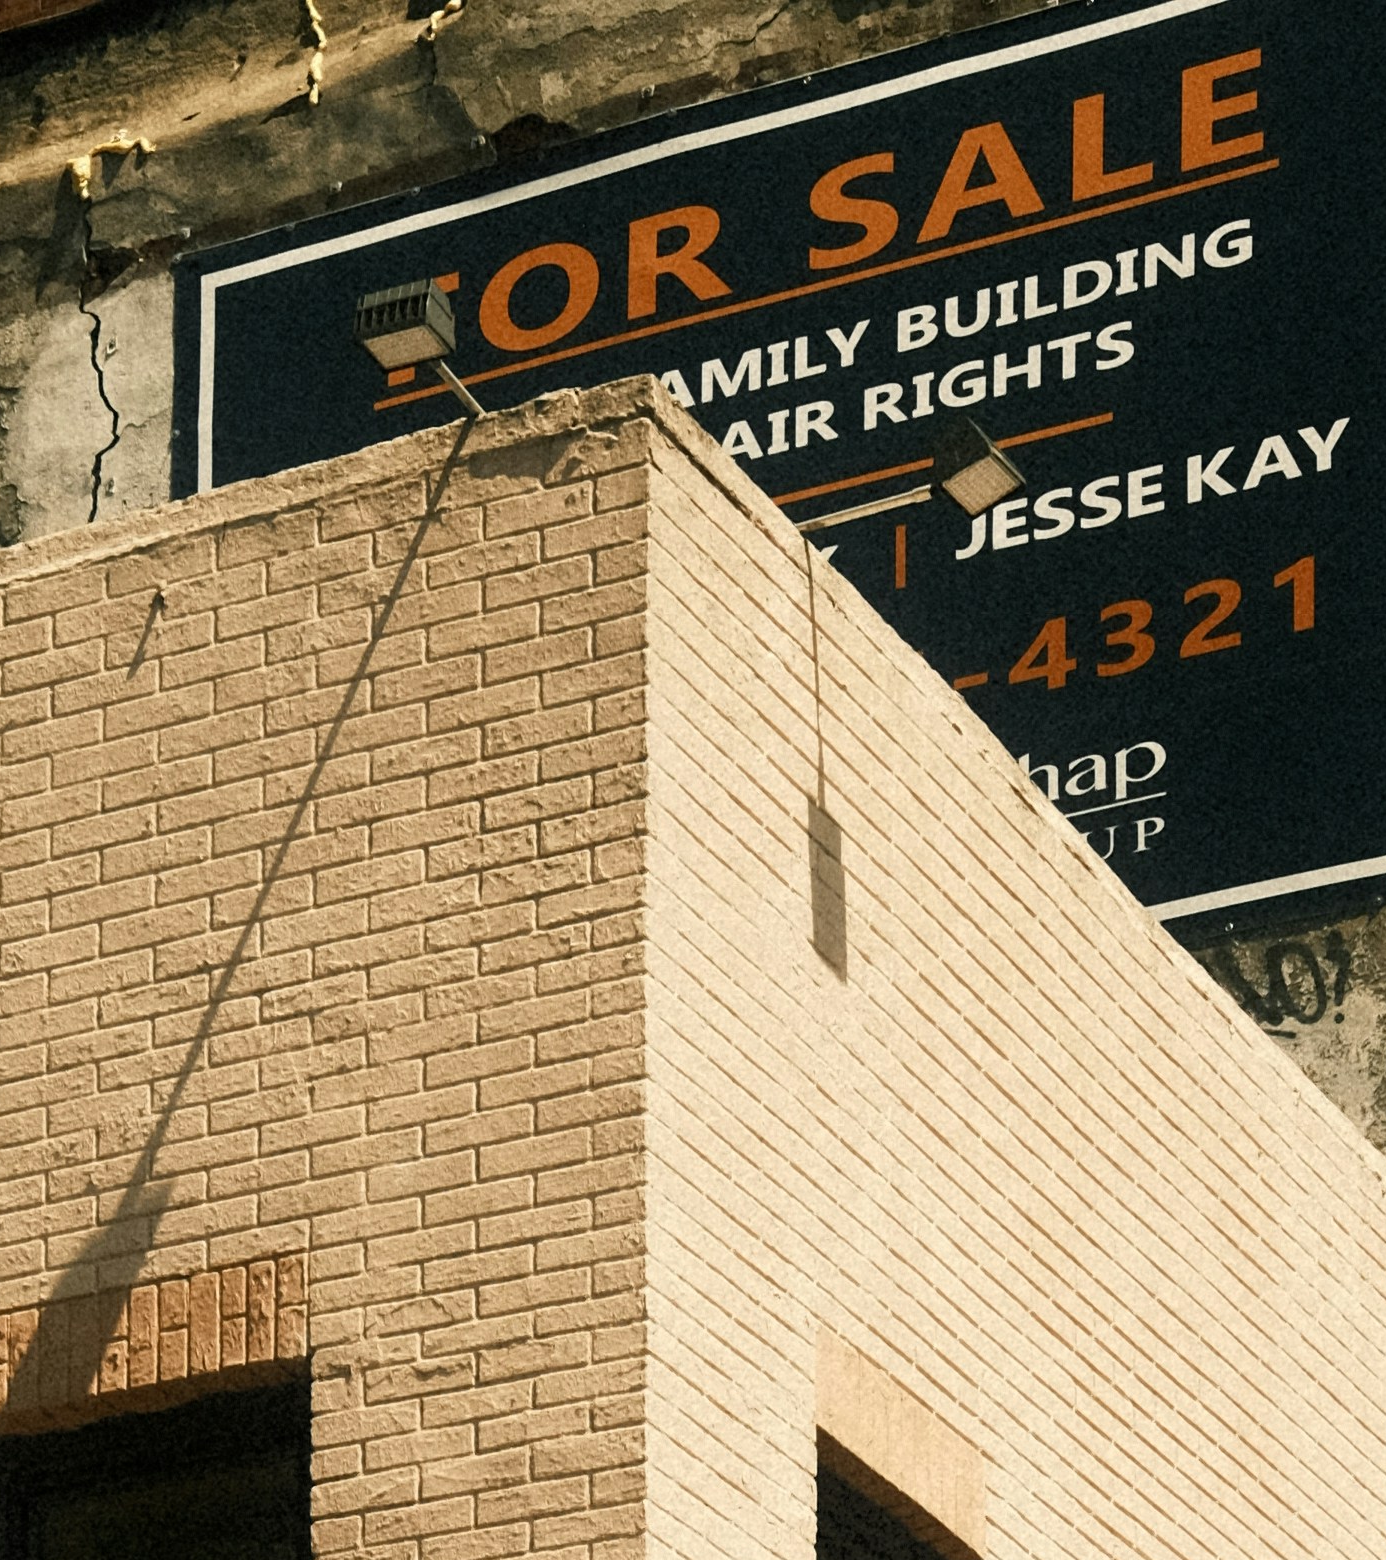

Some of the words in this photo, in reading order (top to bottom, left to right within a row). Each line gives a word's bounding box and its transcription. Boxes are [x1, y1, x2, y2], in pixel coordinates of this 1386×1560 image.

[388, 205, 733, 387] OR
[808, 48, 1263, 271] SALE
[658, 319, 870, 410] AMILY
[896, 218, 1254, 353] BUILDING
[721, 400, 839, 460] AIR
[863, 321, 1136, 431] RIGHTS
[955, 464, 1166, 560] JESSE
[1186, 417, 1351, 505] KAY
